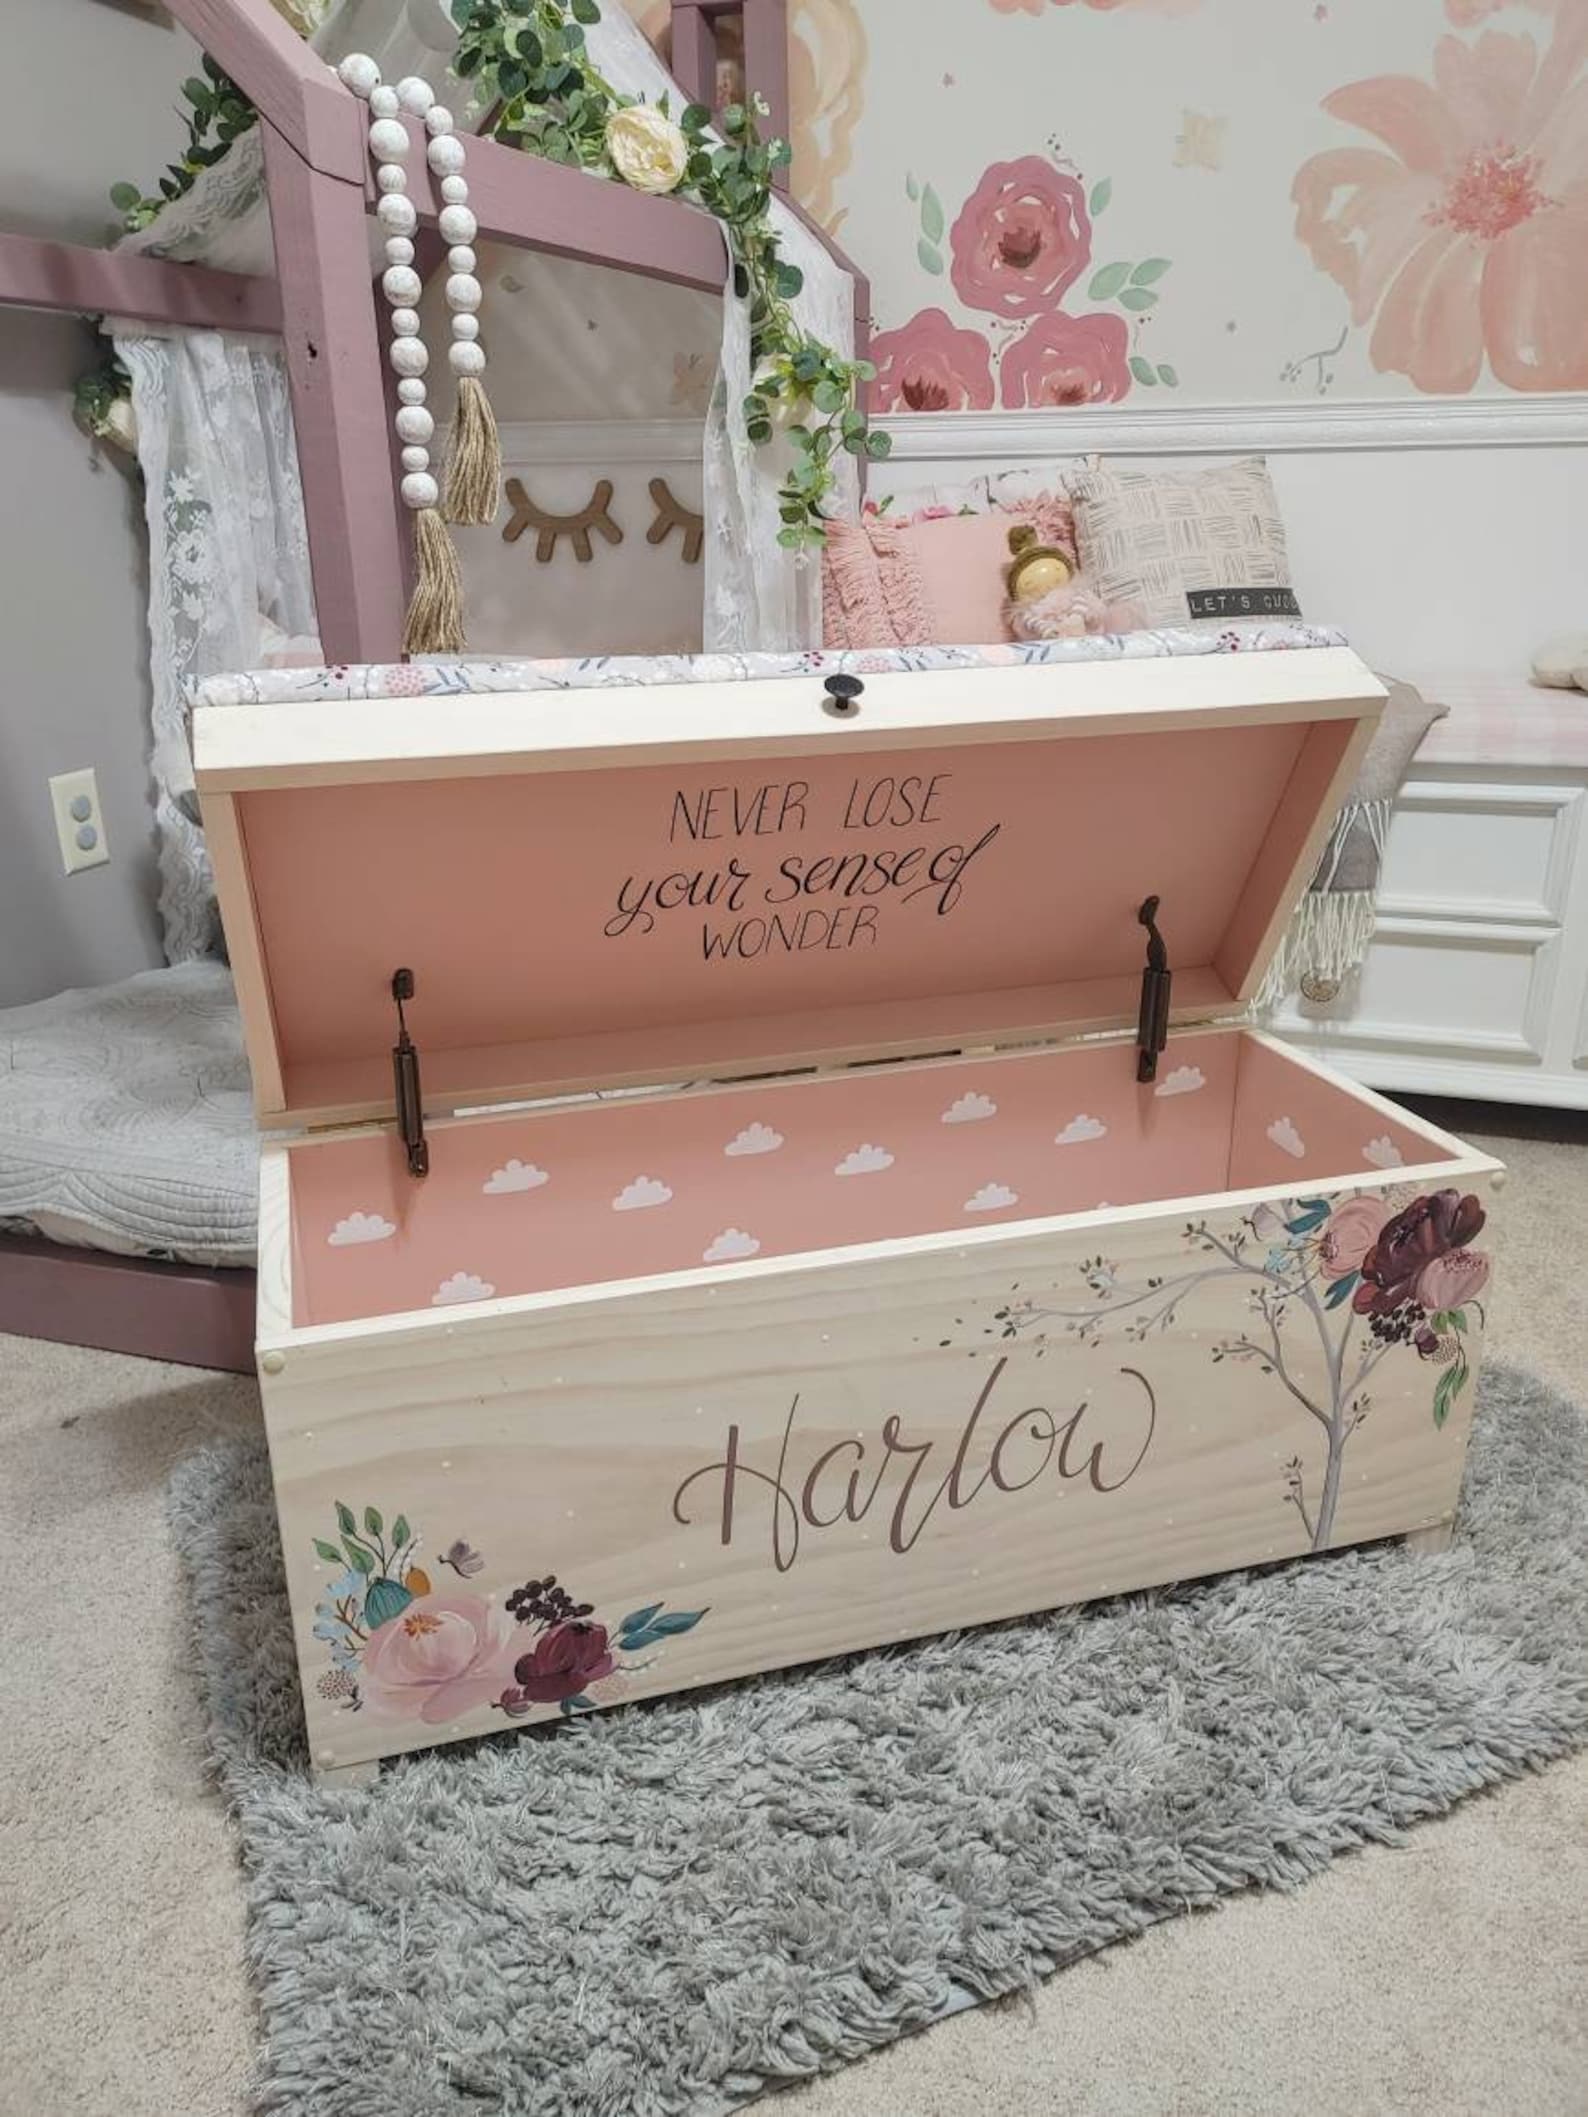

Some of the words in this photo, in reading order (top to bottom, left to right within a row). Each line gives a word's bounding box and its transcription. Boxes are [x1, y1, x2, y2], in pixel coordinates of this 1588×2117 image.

[1189, 595, 1251, 613] LET'S
[669, 781, 809, 843] NEVER
[842, 773, 953, 830] LOSE
[603, 857, 752, 937] your
[764, 846, 926, 903] sense
[901, 823, 1001, 916] of
[702, 905, 880, 961] WONDER
[673, 1356, 1157, 1573] Harlow
